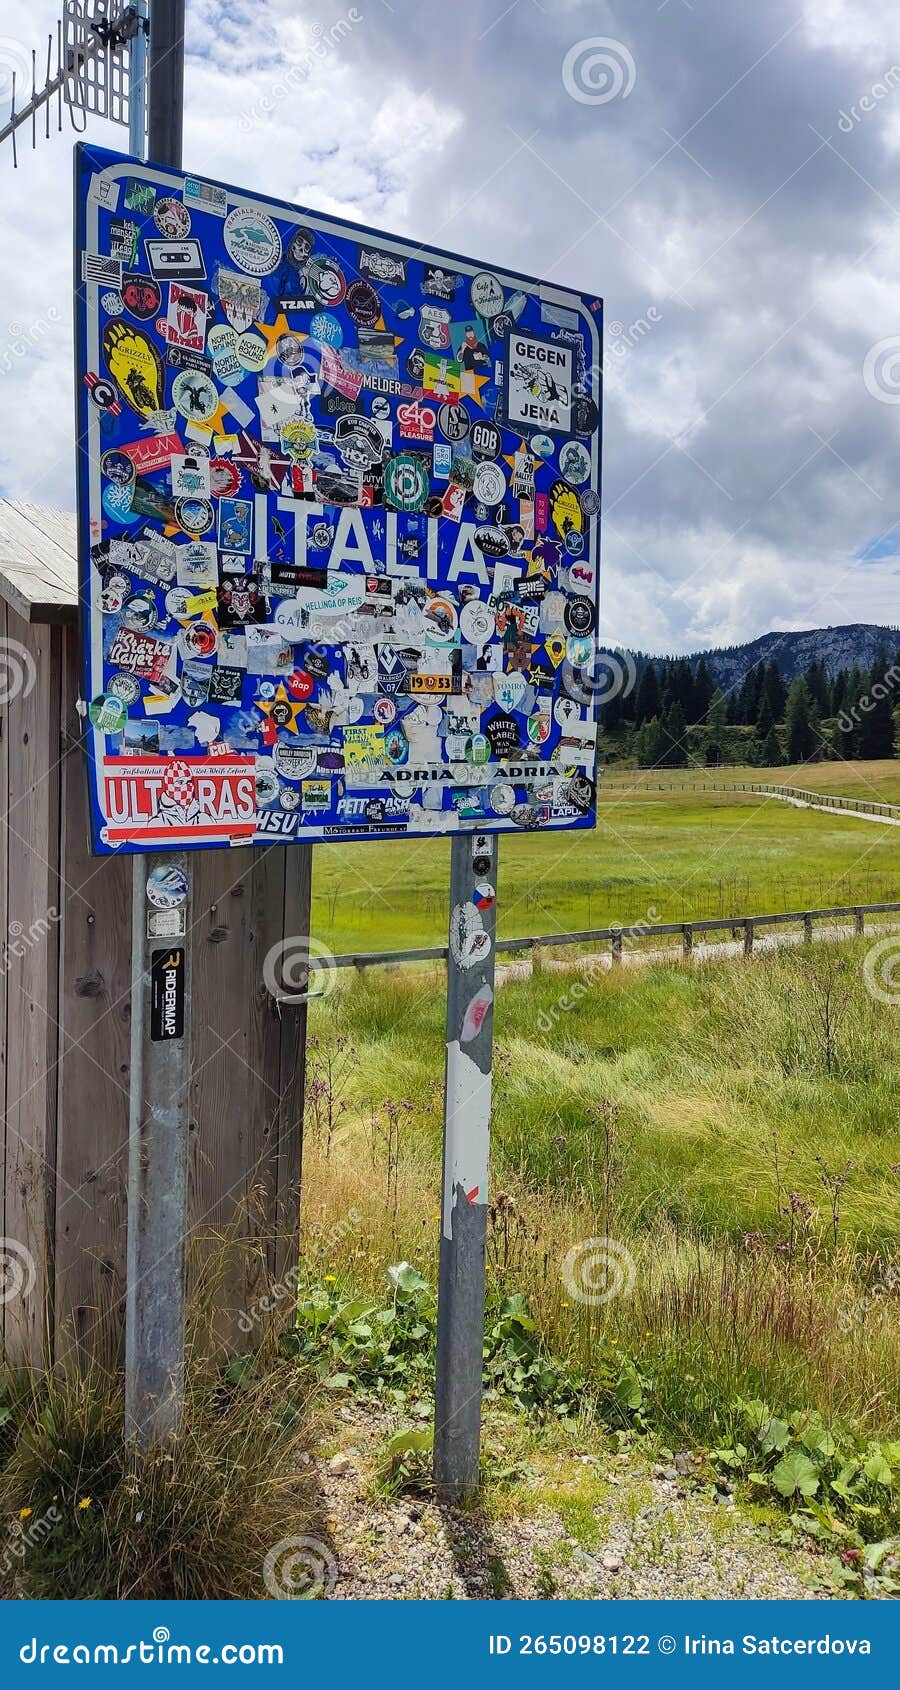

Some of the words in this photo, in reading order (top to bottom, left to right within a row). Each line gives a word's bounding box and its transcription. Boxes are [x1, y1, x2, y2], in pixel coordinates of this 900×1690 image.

[280, 300, 315, 309] TZAR
[211, 332, 235, 345] NORTH
[118, 346, 152, 362] GRIZZLY
[238, 346, 264, 361] BOUND
[241, 339, 265, 355] NORTH
[214, 354, 237, 367] NORTH
[515, 341, 566, 368] GEGEN
[216, 361, 240, 376] BOUND
[363, 375, 401, 395] MELDER
[519, 403, 560, 425] JENA
[400, 431, 434, 441] PLEASURE
[473, 425, 498, 449] GDB
[345, 447, 369, 465] HOG
[524, 461, 534, 475] 20
[254, 493, 491, 585] ITALIA
[305, 600, 336, 611] HELLINGA
[337, 599, 345, 607] OP
[348, 597, 362, 606] REIS
[292, 679, 310, 692] Rap
[412, 676, 423, 688] 19
[438, 677, 450, 689] 53
[487, 721, 517, 732] WHITE
[491, 731, 518, 741] LABEL
[495, 747, 511, 755] HER
[378, 769, 455, 782] ADRIA
[493, 767, 560, 778] ADRIA
[164, 969, 177, 1036] RIDERMAP
